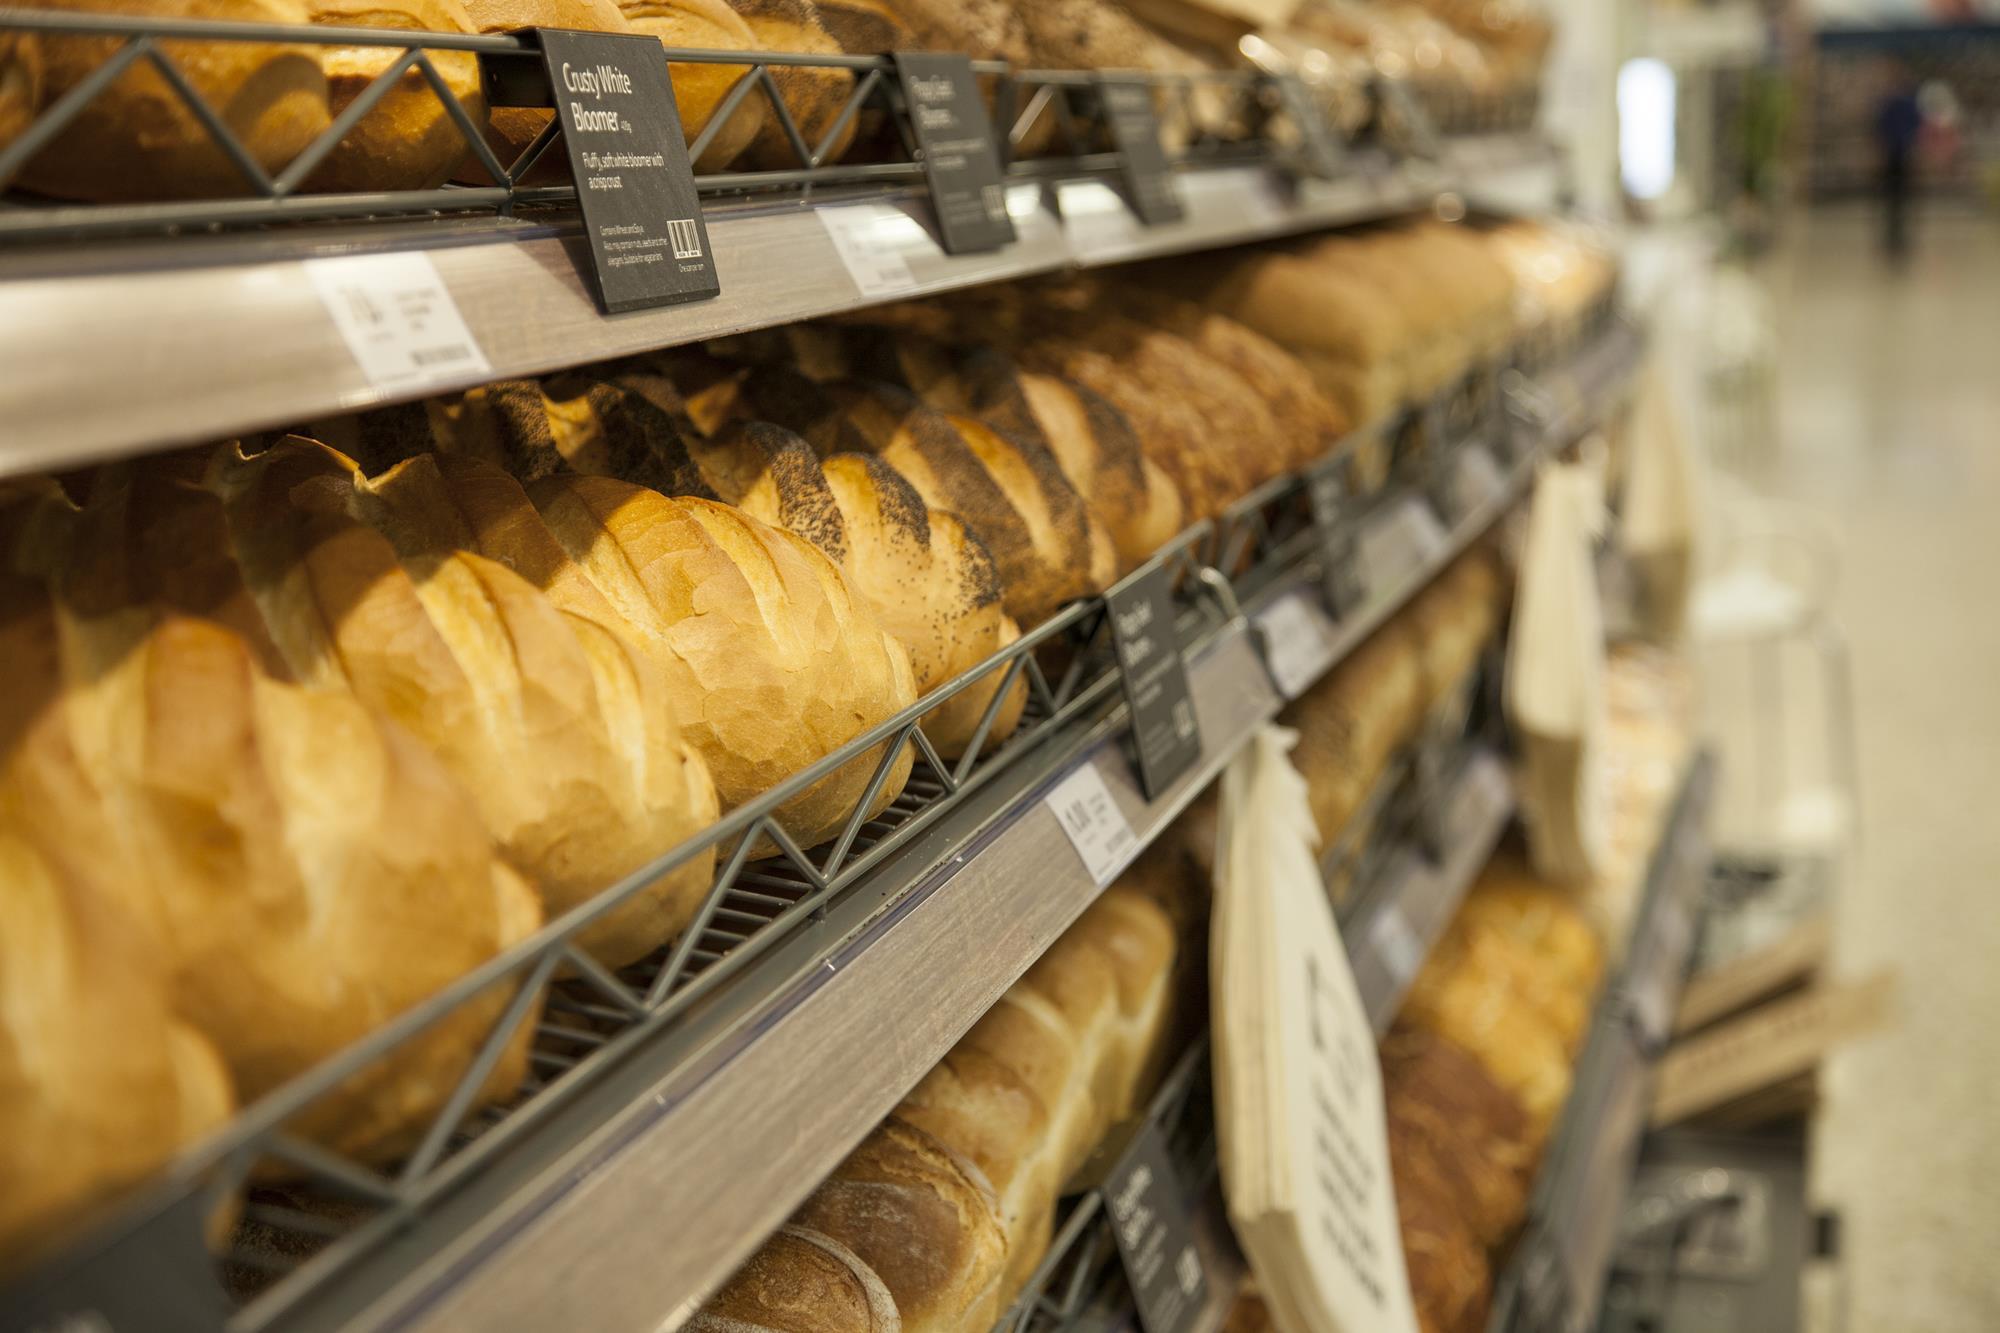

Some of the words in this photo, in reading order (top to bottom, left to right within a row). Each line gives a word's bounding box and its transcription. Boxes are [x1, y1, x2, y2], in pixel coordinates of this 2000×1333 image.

[562, 62, 600, 99] Crusty
[596, 64, 633, 95] White
[570, 102, 619, 132] Bloomer
[614, 151, 630, 167] white
[628, 151, 652, 167] bloomer
[652, 151, 665, 167] with
[606, 176, 623, 189] crust
